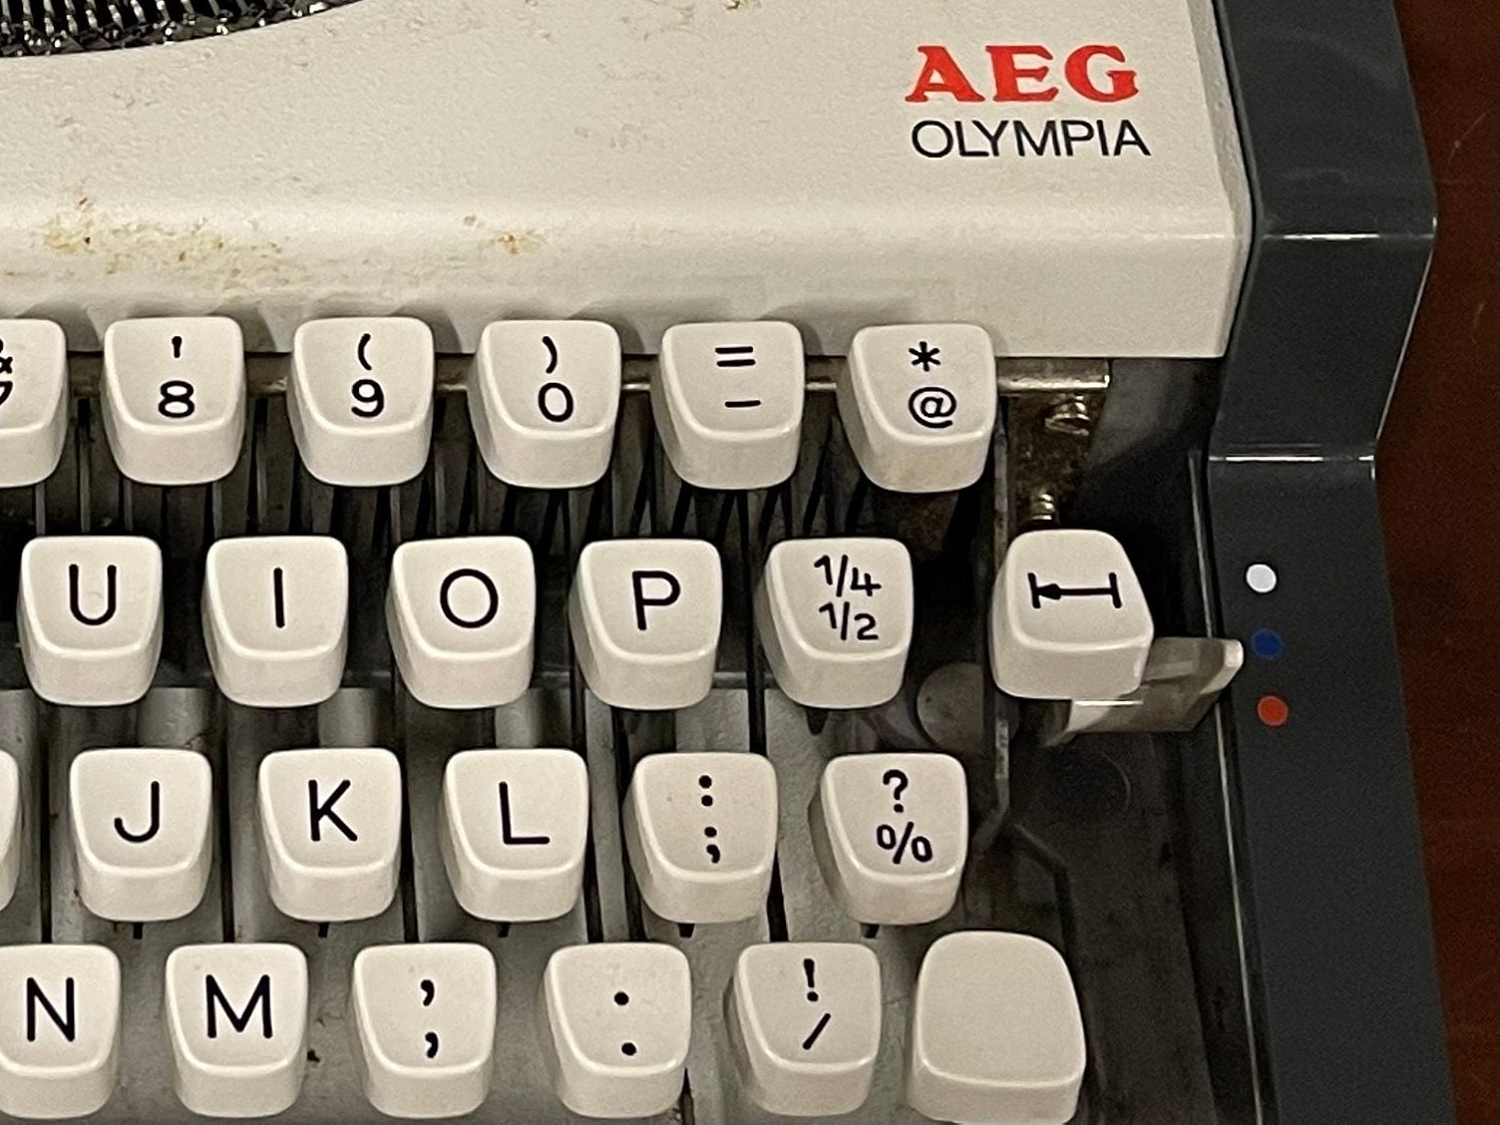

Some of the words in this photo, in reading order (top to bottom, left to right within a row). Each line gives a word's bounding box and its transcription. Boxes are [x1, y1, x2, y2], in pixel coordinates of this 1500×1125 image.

[904, 44, 1140, 103] AEG
[911, 119, 1151, 159] OLYMPIA
[357, 333, 373, 371] (
[541, 335, 558, 374] )
[714, 345, 757, 368] =
[157, 379, 196, 419] 8
[350, 378, 385, 419] 9
[907, 386, 958, 429] @
[68, 563, 117, 626] U
[439, 568, 499, 629] O
[631, 570, 681, 631] P
[113, 780, 160, 844] J
[307, 779, 358, 842] K
[498, 781, 551, 846] L
[882, 769, 909, 814] ?
[876, 821, 933, 865] %
[803, 958, 819, 1003] !
[26, 977, 76, 1043] N
[205, 974, 273, 1040] M
